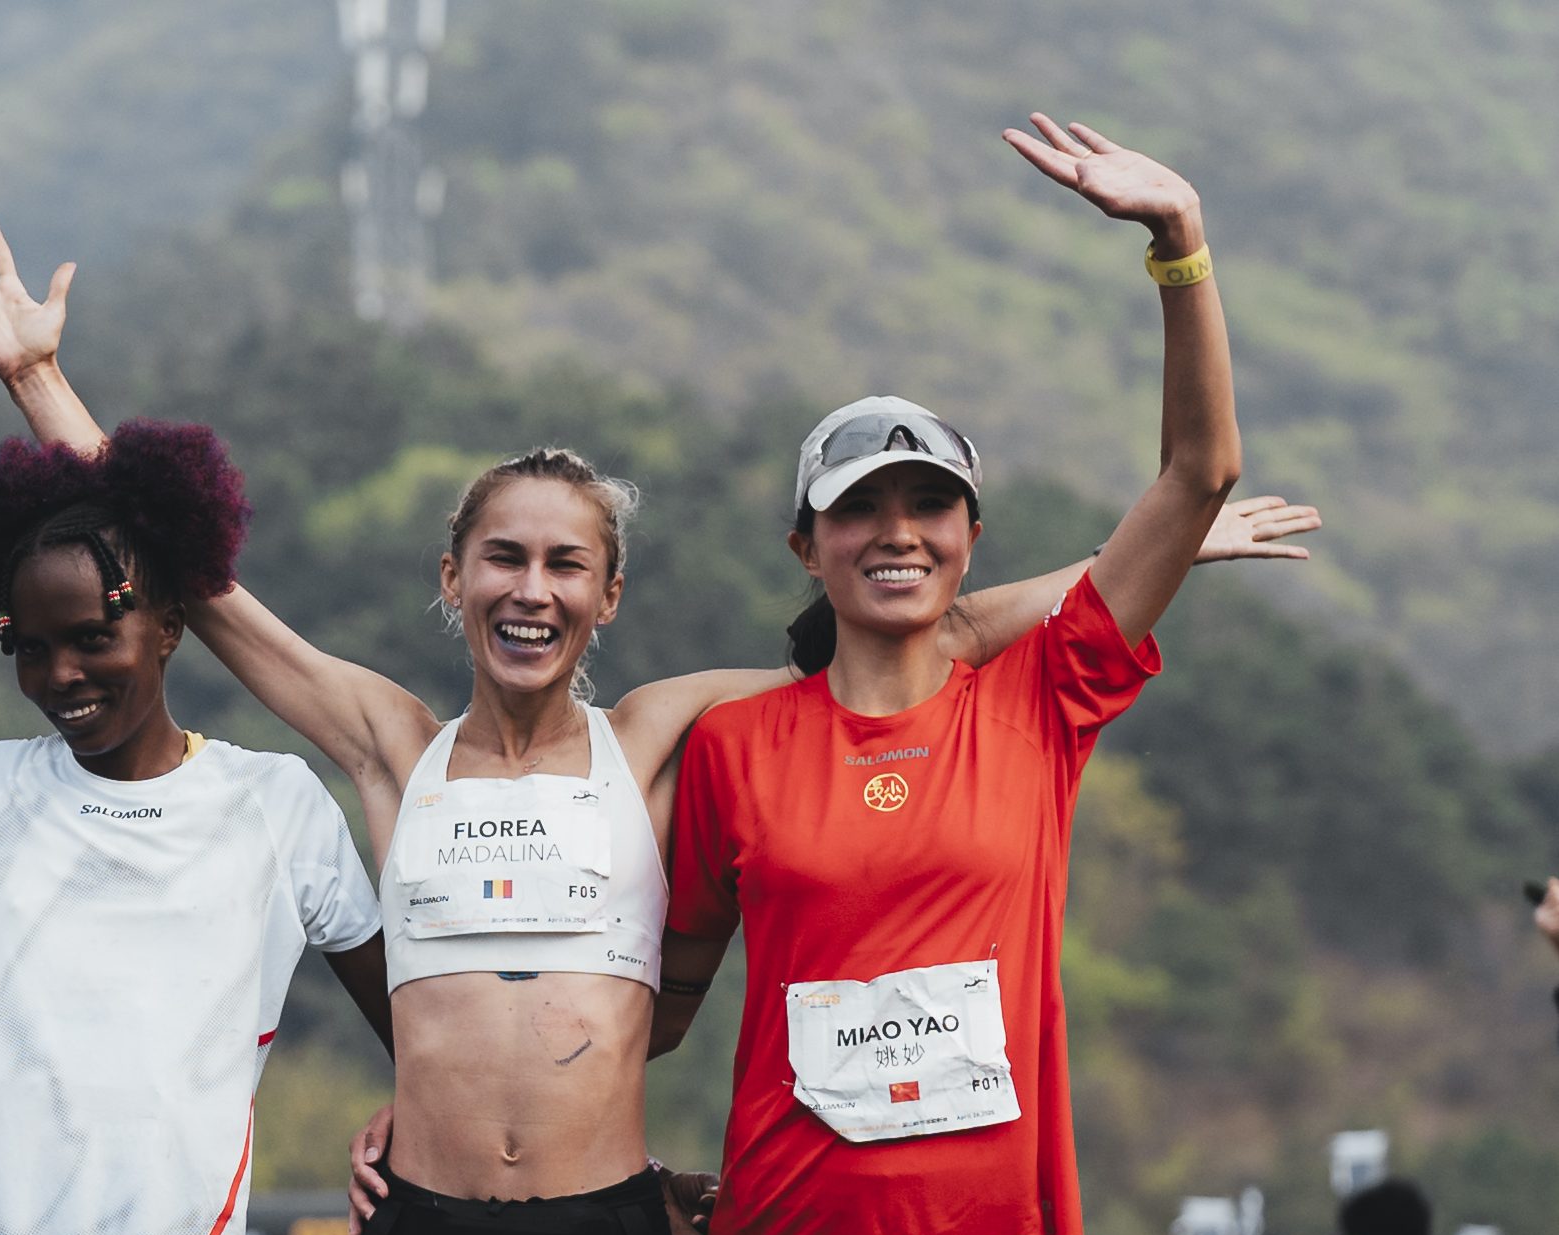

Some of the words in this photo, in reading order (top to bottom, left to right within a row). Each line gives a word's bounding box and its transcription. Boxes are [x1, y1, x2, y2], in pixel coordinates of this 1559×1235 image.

[844, 746, 929, 766] SALOMON
[80, 804, 163, 820] SALOMON
[454, 819, 547, 839] FLOREA
[437, 843, 562, 866] MADALINA
[569, 885, 598, 899] F05
[409, 895, 450, 907] SALOMON
[617, 954, 648, 966] SCOTT
[837, 1020, 902, 1048] MIAO
[907, 1014, 960, 1038] YAO
[972, 1078, 1001, 1093] F01
